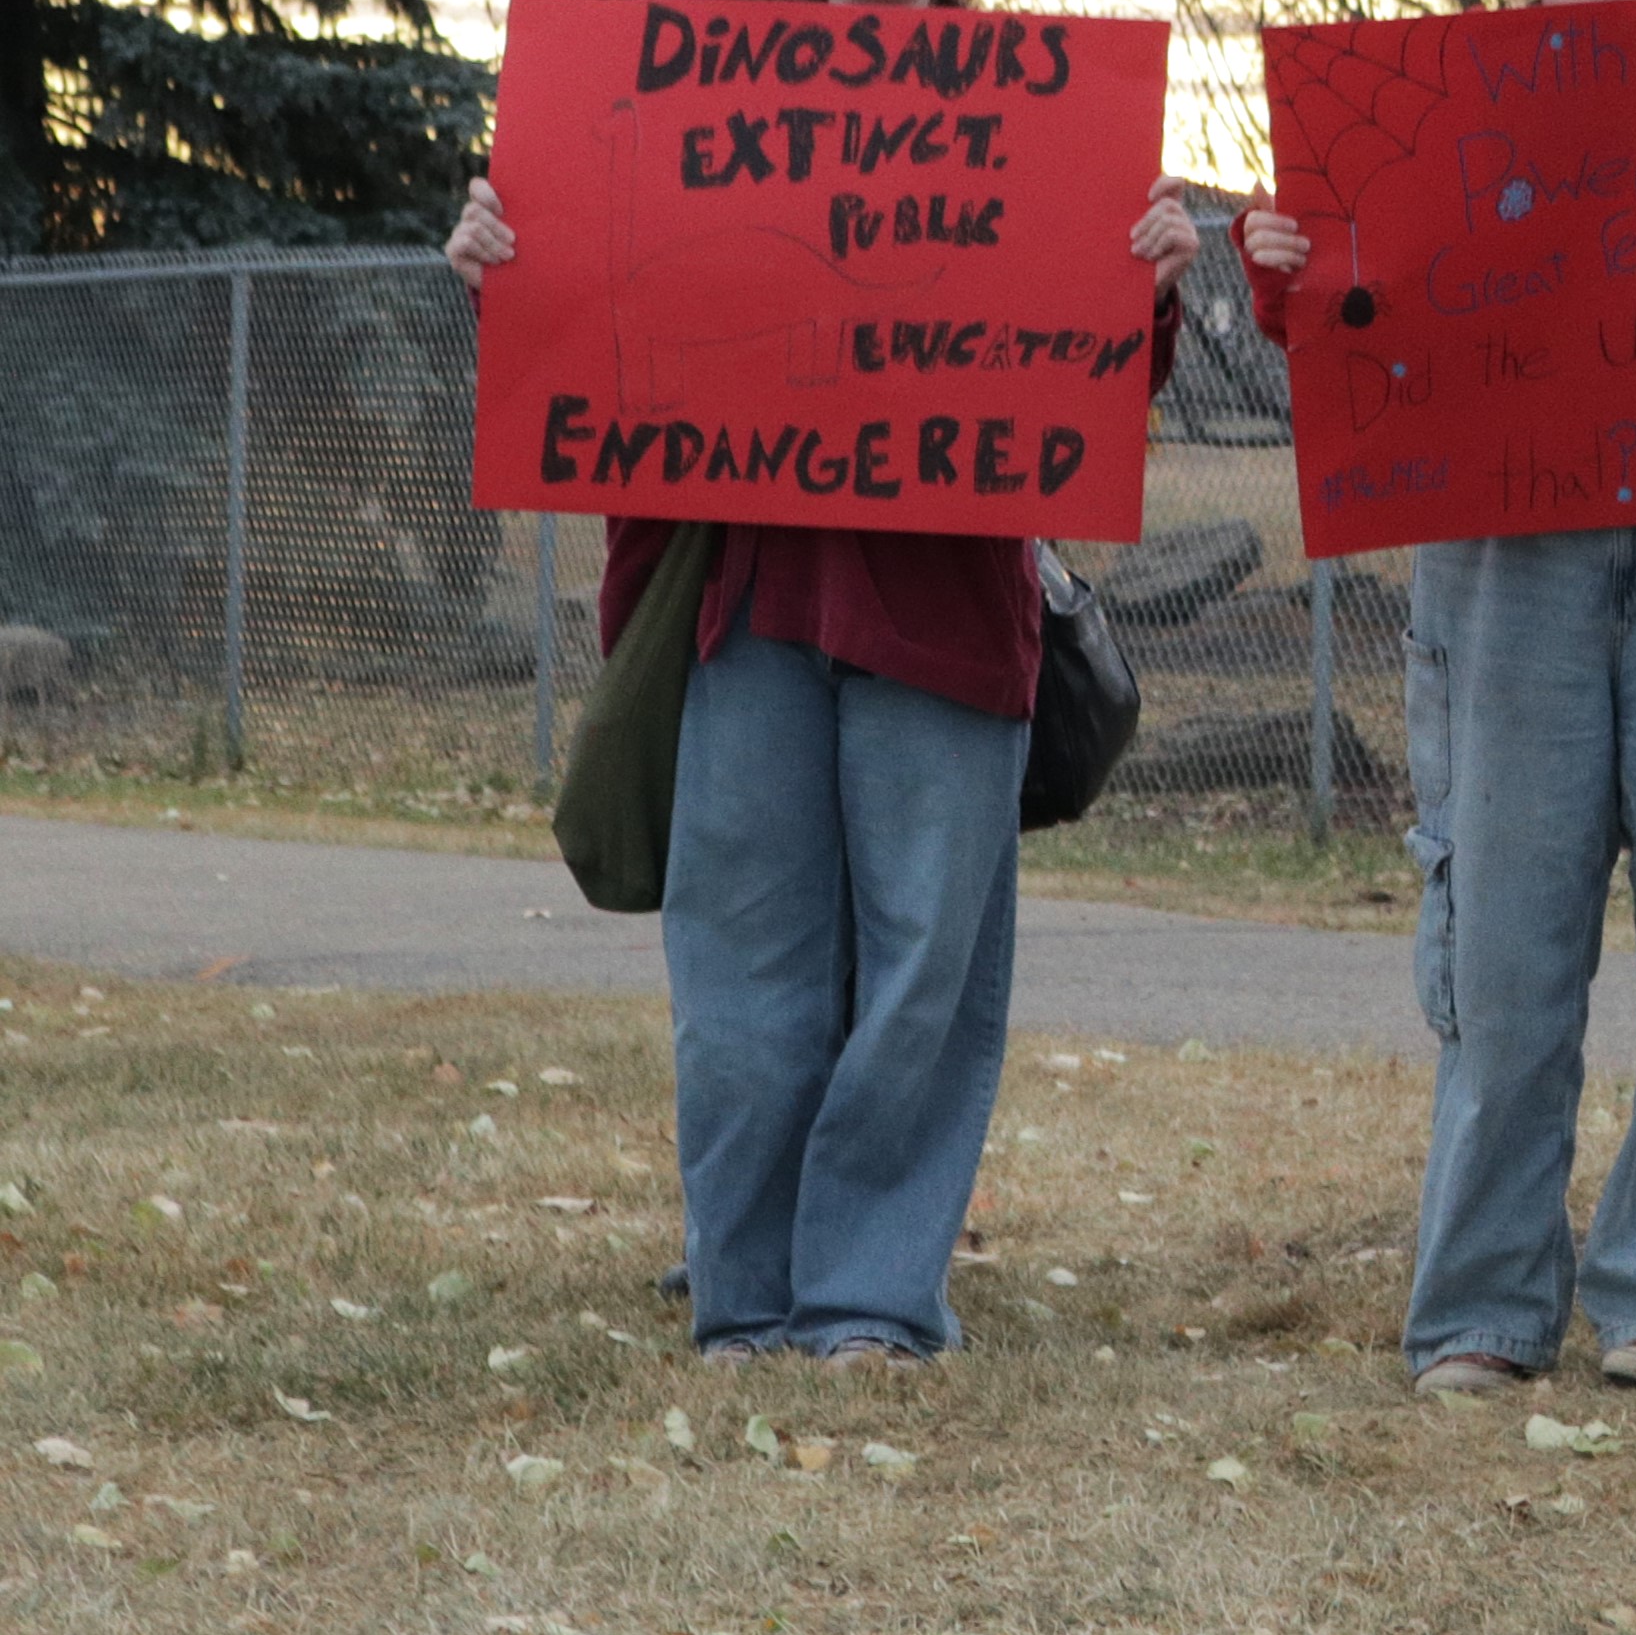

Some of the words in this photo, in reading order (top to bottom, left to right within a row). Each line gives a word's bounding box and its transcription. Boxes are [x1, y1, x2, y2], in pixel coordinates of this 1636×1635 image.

[1467, 16, 1628, 103] With
[679, 106, 1008, 190] EXTINCT.
[827, 192, 1005, 260] PUBLIC
[1427, 244, 1566, 316] Great
[850, 318, 1147, 380] EDUCATION
[1346, 349, 1433, 433] Did
[1475, 332, 1551, 388] the
[540, 393, 1086, 499] ENDANGERED
